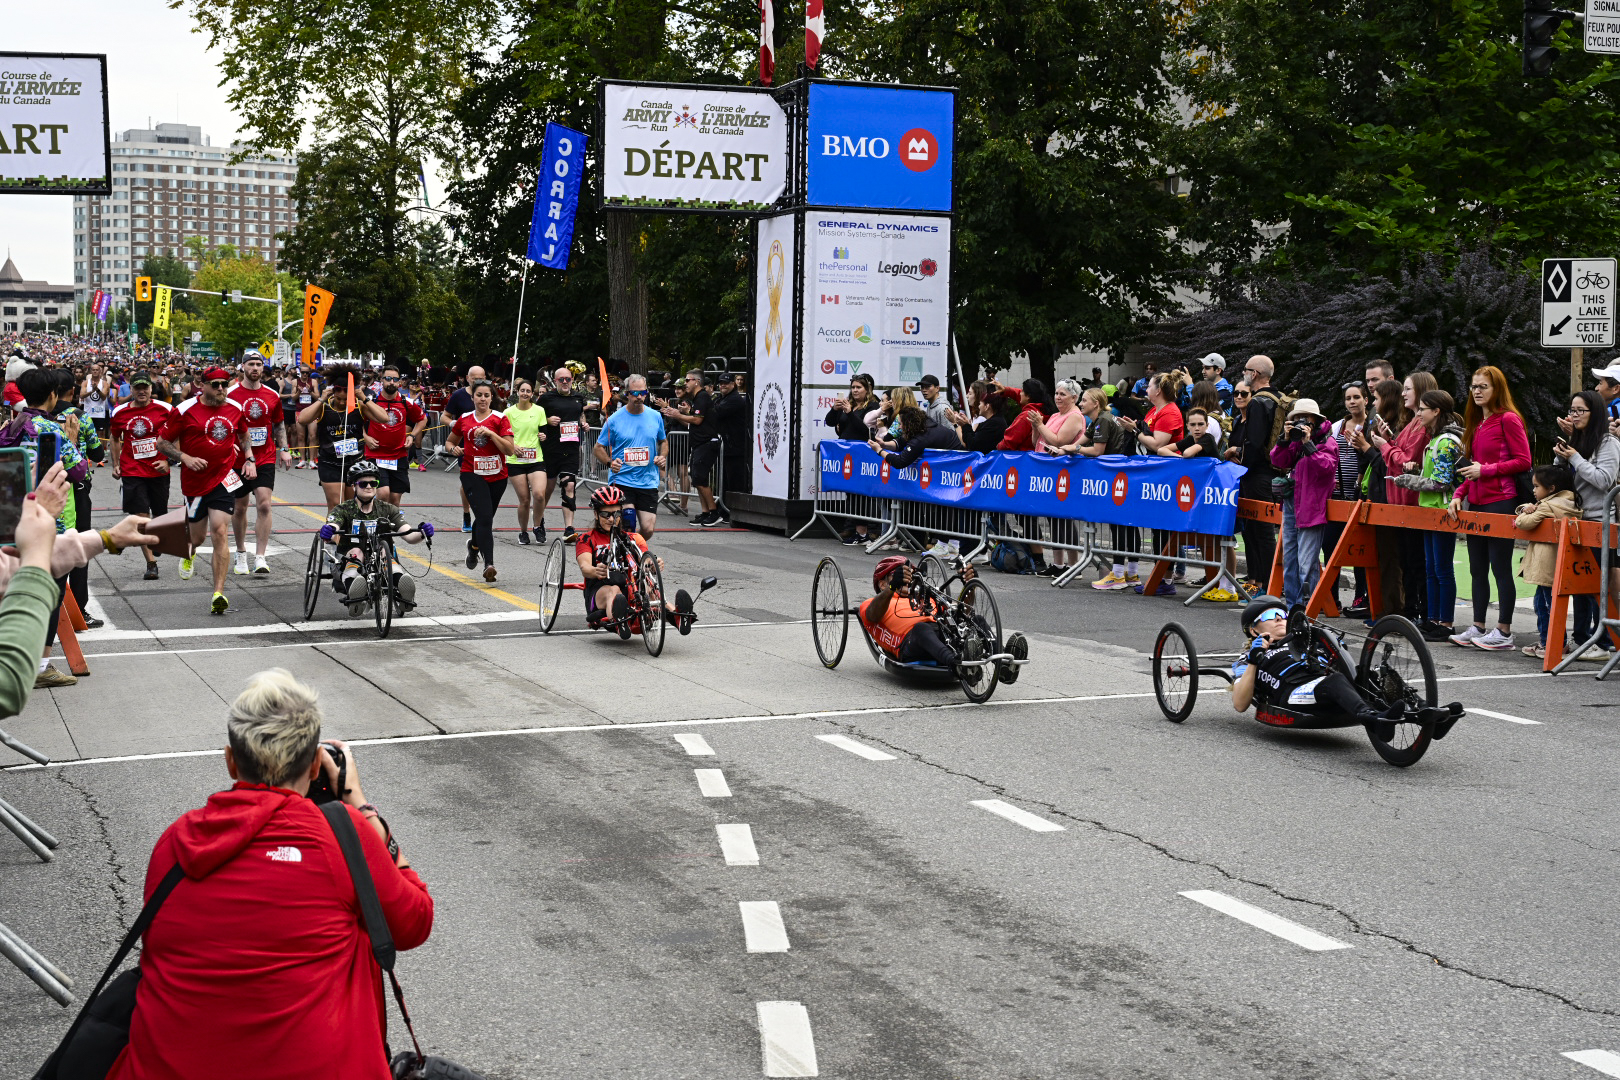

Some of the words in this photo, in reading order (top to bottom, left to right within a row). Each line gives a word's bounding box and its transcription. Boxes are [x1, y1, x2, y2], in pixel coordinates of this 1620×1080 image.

[1588, 22, 1605, 33] FEUX
[1588, 36, 1620, 48] CYCLISTE
[1, 71, 37, 80] Course
[39, 71, 52, 80] de
[0, 78, 82, 95] L'ARMÉE
[13, 96, 51, 105] Canada
[641, 100, 673, 110] Canada
[704, 104, 733, 113] Course
[735, 104, 746, 114] de
[623, 108, 672, 123] ARMY
[701, 111, 770, 128] L'ARMÉE
[651, 123, 668, 132] Run
[699, 126, 710, 134] du
[712, 127, 744, 136] Canada
[822, 134, 890, 158] BMO
[624, 139, 769, 181] DÉPART
[818, 220, 873, 230] GENERAL
[876, 223, 939, 233] DYNAMICS
[818, 229, 846, 237] Mission
[819, 262, 868, 272] thePersonal
[878, 261, 918, 276] Legion
[1582, 295, 1605, 304] THIS
[1579, 307, 1607, 316] LANE
[817, 326, 851, 337] Accora
[1577, 323, 1608, 332] CETTE
[881, 338, 940, 347] COMMISSIONAIRES
[1581, 334, 1604, 343] VOIE
[821, 360, 863, 374] CTV
[476, 461, 497, 470] 10035
[823, 458, 840, 474] BMO
[861, 462, 878, 477] BMO
[898, 467, 918, 482] BMO
[941, 470, 961, 487] BMO
[980, 474, 1003, 490] BMO
[1029, 476, 1053, 493] BMO
[1081, 478, 1108, 497] BMO
[1141, 482, 1172, 502] BMO
